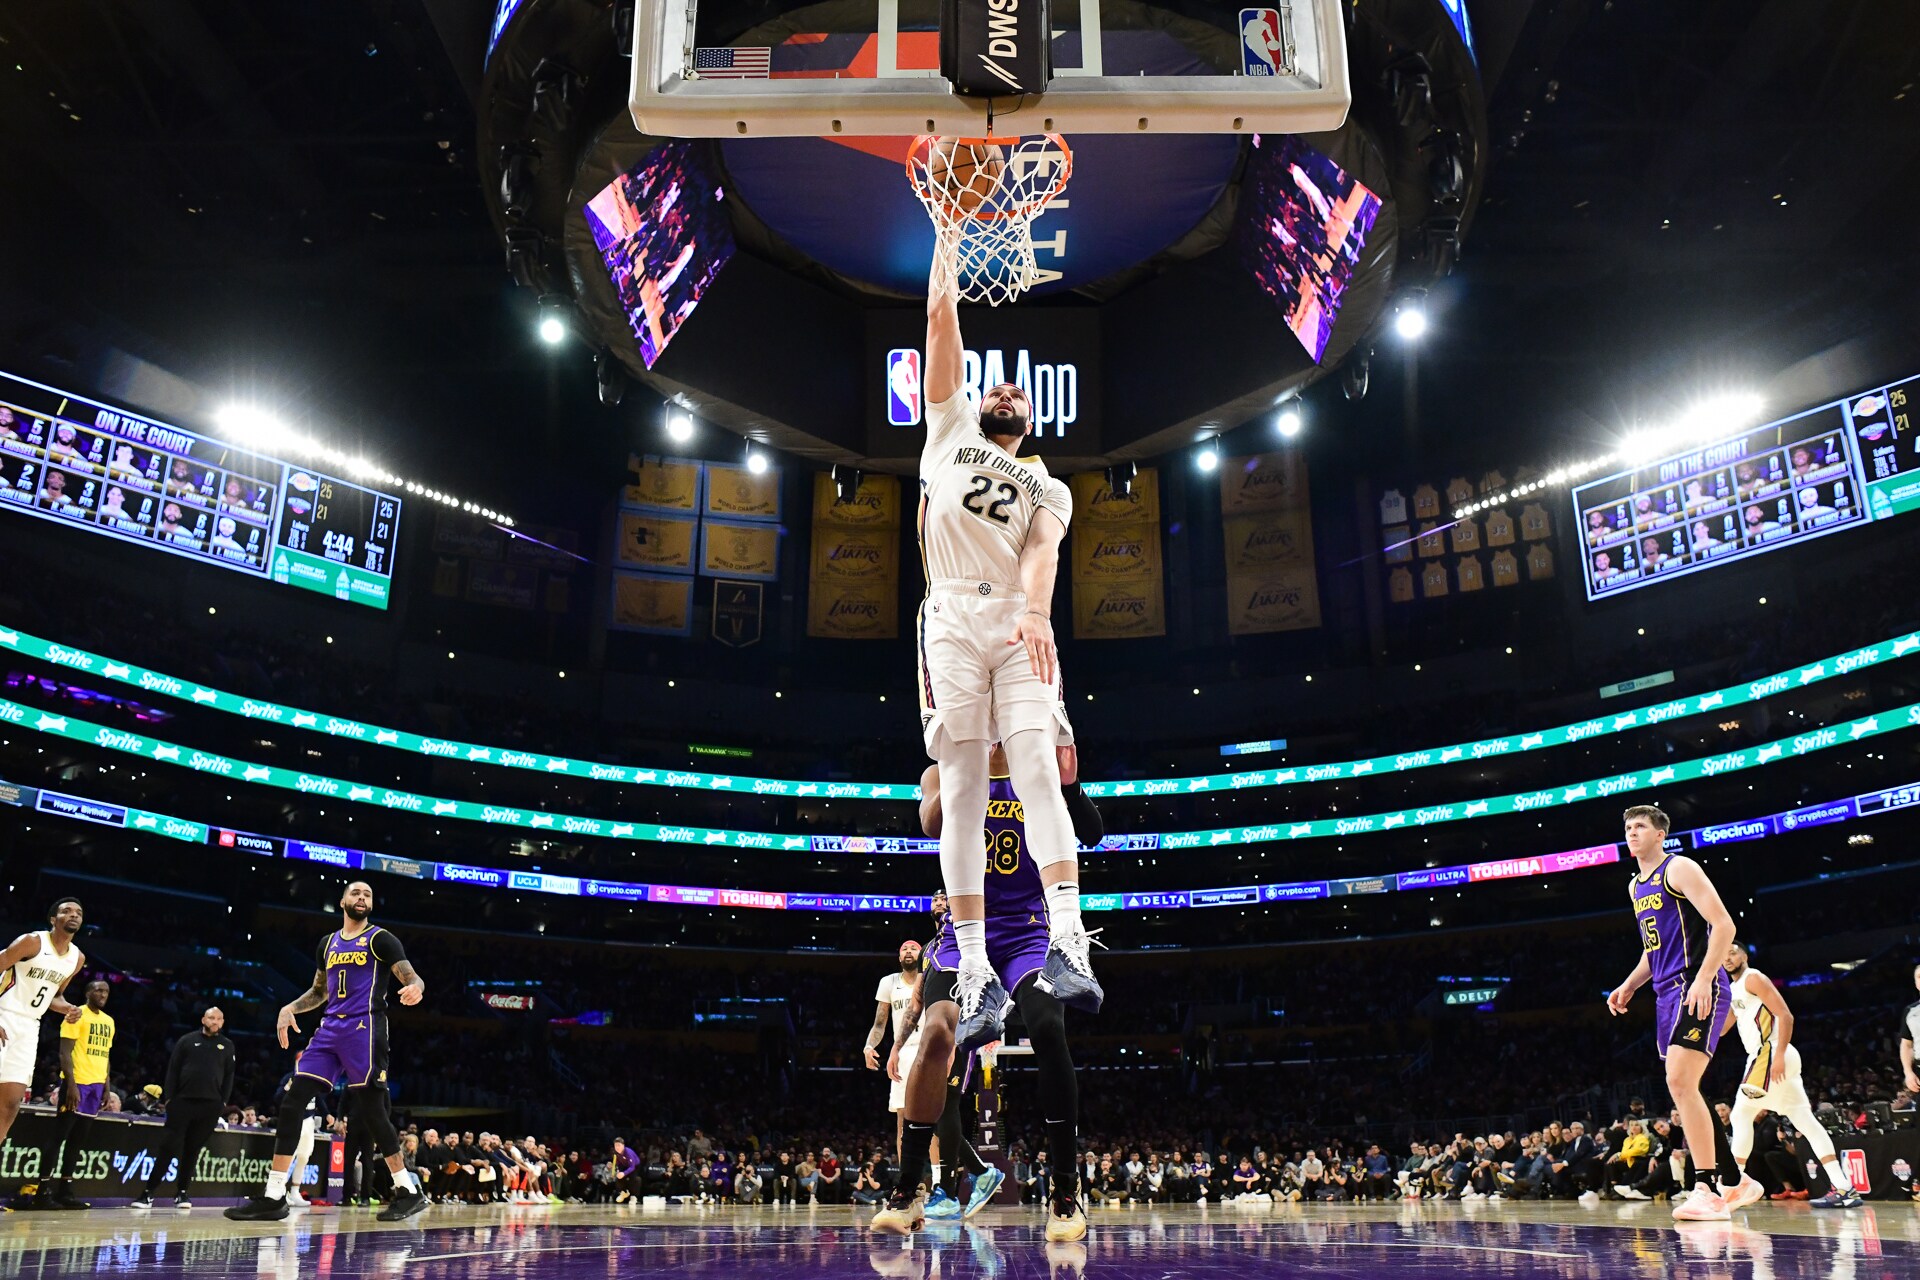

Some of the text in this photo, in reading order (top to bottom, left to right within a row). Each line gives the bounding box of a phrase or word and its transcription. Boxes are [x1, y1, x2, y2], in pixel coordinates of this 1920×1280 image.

[1249, 63, 1269, 76] NBA
[1016, 349, 1077, 438] App
[1889, 389, 1907, 408] 25
[31, 419, 44, 435] 5
[1895, 413, 1910, 431] 21
[95, 410, 195, 455] ON THE COURT
[92, 437, 104, 453] 8
[1824, 437, 1835, 454] 7
[150, 454, 161, 469] 5
[1660, 438, 1748, 482] ON THE COURT
[1768, 455, 1779, 472] 0
[20, 464, 35, 480] 2
[205, 472, 215, 487] 0
[953, 447, 1044, 507] NEW ORLEANS
[1715, 473, 1725, 488] 5
[82, 481, 95, 497] 3
[257, 487, 267, 501] 7
[320, 483, 332, 499] 25
[1665, 489, 1674, 505] 8
[1834, 481, 1845, 499] 0
[140, 498, 152, 514] 0
[718, 498, 737, 511] WORLD
[962, 475, 1018, 524] 22
[1778, 498, 1787, 514] 6
[317, 504, 327, 520] 21
[380, 501, 393, 518] 25
[1616, 504, 1625, 519] 5
[196, 514, 207, 529] 6
[1724, 515, 1733, 531] 0
[249, 529, 260, 543] 0
[377, 522, 388, 539] 21
[1492, 524, 1508, 536] 32
[1672, 530, 1682, 545] 3
[322, 530, 354, 556] 4:44
[1093, 542, 1143, 559] LAKERS
[830, 544, 881, 563] LAKERS
[1623, 545, 1632, 560] 2
[714, 556, 734, 569] WORLD
[1498, 564, 1512, 576] 24
[1535, 558, 1547, 569] 16
[828, 599, 880, 618] LAKERS
[1094, 599, 1146, 616] LAKERS
[45, 645, 93, 669] Sprite
[1835, 647, 1879, 674] Sprite
[139, 671, 182, 695] Sprite
[1748, 675, 1789, 700] Sprite
[240, 699, 282, 720] Sprite
[1646, 700, 1687, 724] Sprite
[325, 718, 365, 738] Sprite
[1566, 719, 1603, 742] Sprite
[95, 728, 142, 752] Sprite
[420, 739, 458, 756] Sprite
[1235, 740, 1271, 749] AMERICAN
[1792, 729, 1837, 754] Sprite
[1471, 740, 1509, 758] Sprite
[189, 752, 232, 775] Sprite
[499, 751, 536, 767] Sprite
[1394, 752, 1431, 770] Sprite
[1702, 753, 1746, 777] Sprite
[589, 764, 626, 780] Sprite
[664, 772, 701, 787] Sprite
[1304, 765, 1341, 782] Sprite
[295, 774, 339, 794] Sprite
[752, 779, 787, 794] Sprite
[1143, 781, 1178, 795] Sprite
[1230, 773, 1266, 789] Sprite
[1596, 775, 1637, 797] Sprite
[825, 784, 861, 798] Sprite
[1880, 786, 1920, 807] 7:57
[382, 791, 422, 810] Sprite
[1513, 792, 1553, 811] Sprite
[53, 799, 113, 820] Happy Birthday
[481, 806, 521, 824] Sprite
[1415, 807, 1453, 825] Sprite
[1797, 804, 1849, 824] crypto.com
[163, 819, 199, 838] Sprite
[562, 817, 600, 833] Sprite
[1335, 818, 1373, 835] Sprite
[1702, 822, 1764, 844] Spectrum
[656, 826, 695, 842] Sprite
[735, 833, 773, 848] Sprite
[1163, 834, 1200, 849] Sprite
[1240, 827, 1278, 844] Sprite
[236, 836, 273, 850] TOYOTA
[303, 844, 347, 858] AMERICAN
[818, 842, 824, 850] 6
[832, 842, 838, 850] 4
[883, 840, 900, 852] 25
[1133, 841, 1139, 849] 3
[1147, 840, 1153, 849] 7
[309, 852, 347, 865] EXPRESS
[1556, 850, 1604, 867] boldyn
[444, 866, 499, 883] Spectrum
[1436, 870, 1466, 882] ULTRA
[1471, 859, 1540, 879] TOSHIBA
[517, 876, 576, 892] UCLA Health
[599, 885, 642, 896] crypto.com
[1278, 885, 1321, 897] crypto.com
[721, 892, 783, 907] TOSHIBA
[823, 898, 850, 907] ULTRA
[873, 898, 916, 909] DELTA
[1086, 896, 1116, 909] Sprite
[1142, 895, 1186, 906] DELTA
[1201, 892, 1247, 903] Happy Birthday
[1640, 916, 1661, 953] 15
[326, 951, 368, 969] LAKERS
[25, 967, 46, 980] NEW
[337, 969, 347, 998] 1
[31, 986, 48, 1008] 5
[113, 1151, 129, 1173] by
